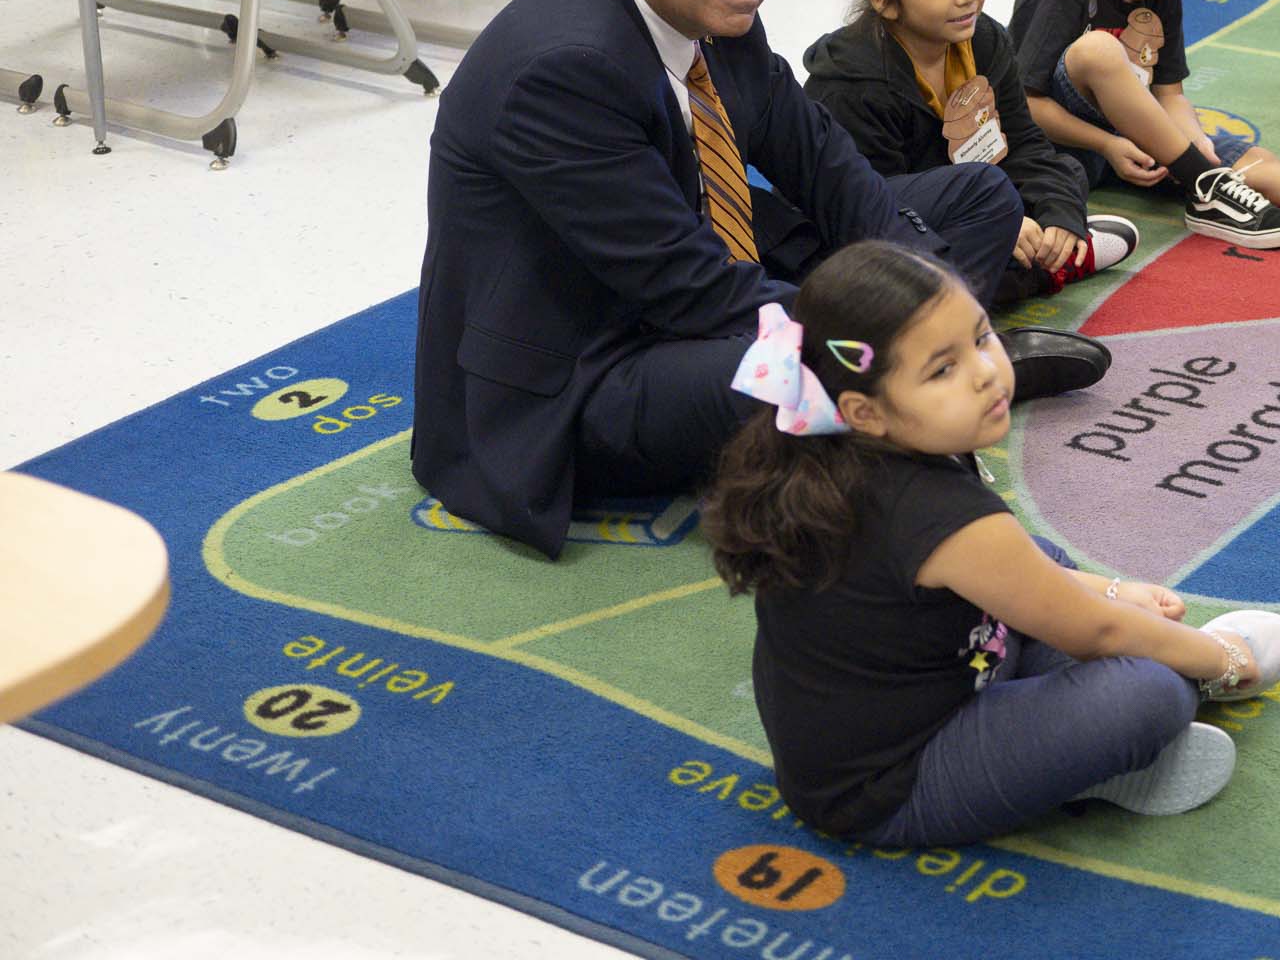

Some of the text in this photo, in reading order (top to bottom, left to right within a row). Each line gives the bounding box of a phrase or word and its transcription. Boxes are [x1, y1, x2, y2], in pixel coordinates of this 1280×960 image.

[199, 365, 300, 407] two
[278, 390, 329, 409] 2
[1063, 355, 1238, 463] purple
[312, 393, 403, 435] dos
[264, 482, 410, 546] book
[282, 634, 455, 705] veinte
[254, 688, 353, 731] 20
[133, 705, 338, 794] twenty
[736, 850, 824, 902] 19
